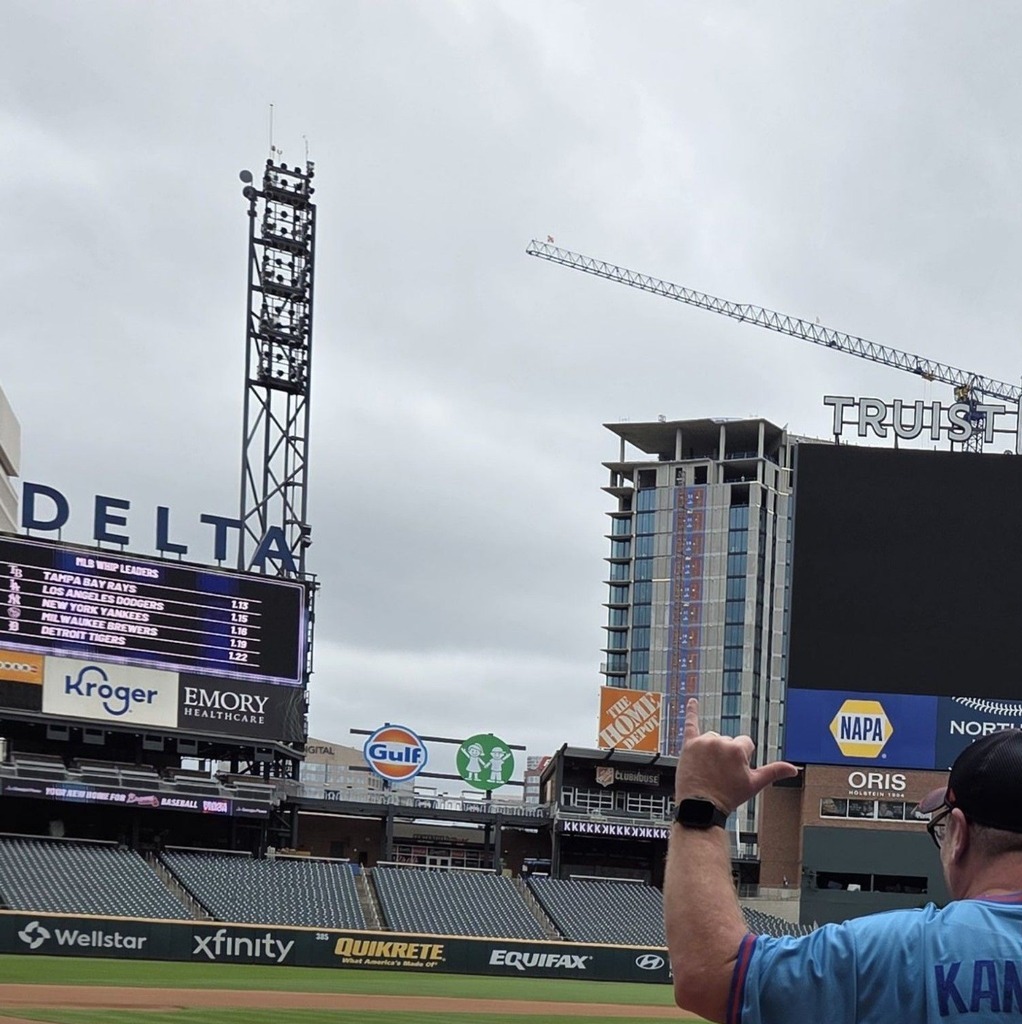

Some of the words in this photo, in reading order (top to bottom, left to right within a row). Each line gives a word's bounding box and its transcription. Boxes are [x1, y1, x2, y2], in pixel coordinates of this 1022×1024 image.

[823, 395, 1006, 444] TRUIST
[21, 481, 299, 577] DELTA
[75, 557, 95, 568] MLB
[120, 564, 159, 578] LEADERS
[43, 571, 81, 586] TAMPA
[82, 577, 106, 589] BAY
[107, 581, 138, 593] RAYS
[42, 585, 65, 596] LOS
[65, 588, 115, 604] ANGELES
[116, 596, 165, 611] DODGERS
[231, 600, 250, 611] 1.13
[42, 598, 68, 610] NEW
[70, 603, 99, 615] YORK
[100, 607, 150, 622] YANKEES
[230, 613, 249, 624] 1.15
[41, 612, 106, 629] MILWAUKEE
[107, 621, 159, 636] BREWERS
[41, 625, 88, 640] DETROIT
[89, 632, 126, 646] TIGERS
[228, 651, 249, 662] 1.22
[65, 665, 158, 716] Kroger
[184, 686, 270, 715] EMORY
[184, 707, 265, 725] HEALTHCARE
[606, 696, 631, 719] THE
[600, 692, 660, 748] HOME
[839, 714, 883, 743] NAPA
[622, 715, 659, 749] DEPOT
[305, 746, 335, 755] IGITAL
[368, 743, 421, 763] Gulf
[615, 770, 659, 784] CLUBHOUSE
[848, 771, 906, 791] ORIS
[110, 793, 126, 802] FOR
[161, 798, 198, 809] BASEBALL
[54, 929, 147, 949] Wellstar
[193, 928, 294, 962] xfinity
[316, 932, 330, 941] 385
[334, 937, 445, 960] QUIKRETE
[342, 957, 362, 965] What
[364, 958, 401, 966] America's
[403, 960, 424, 968] Made
[489, 949, 588, 970] EQUIFAX
